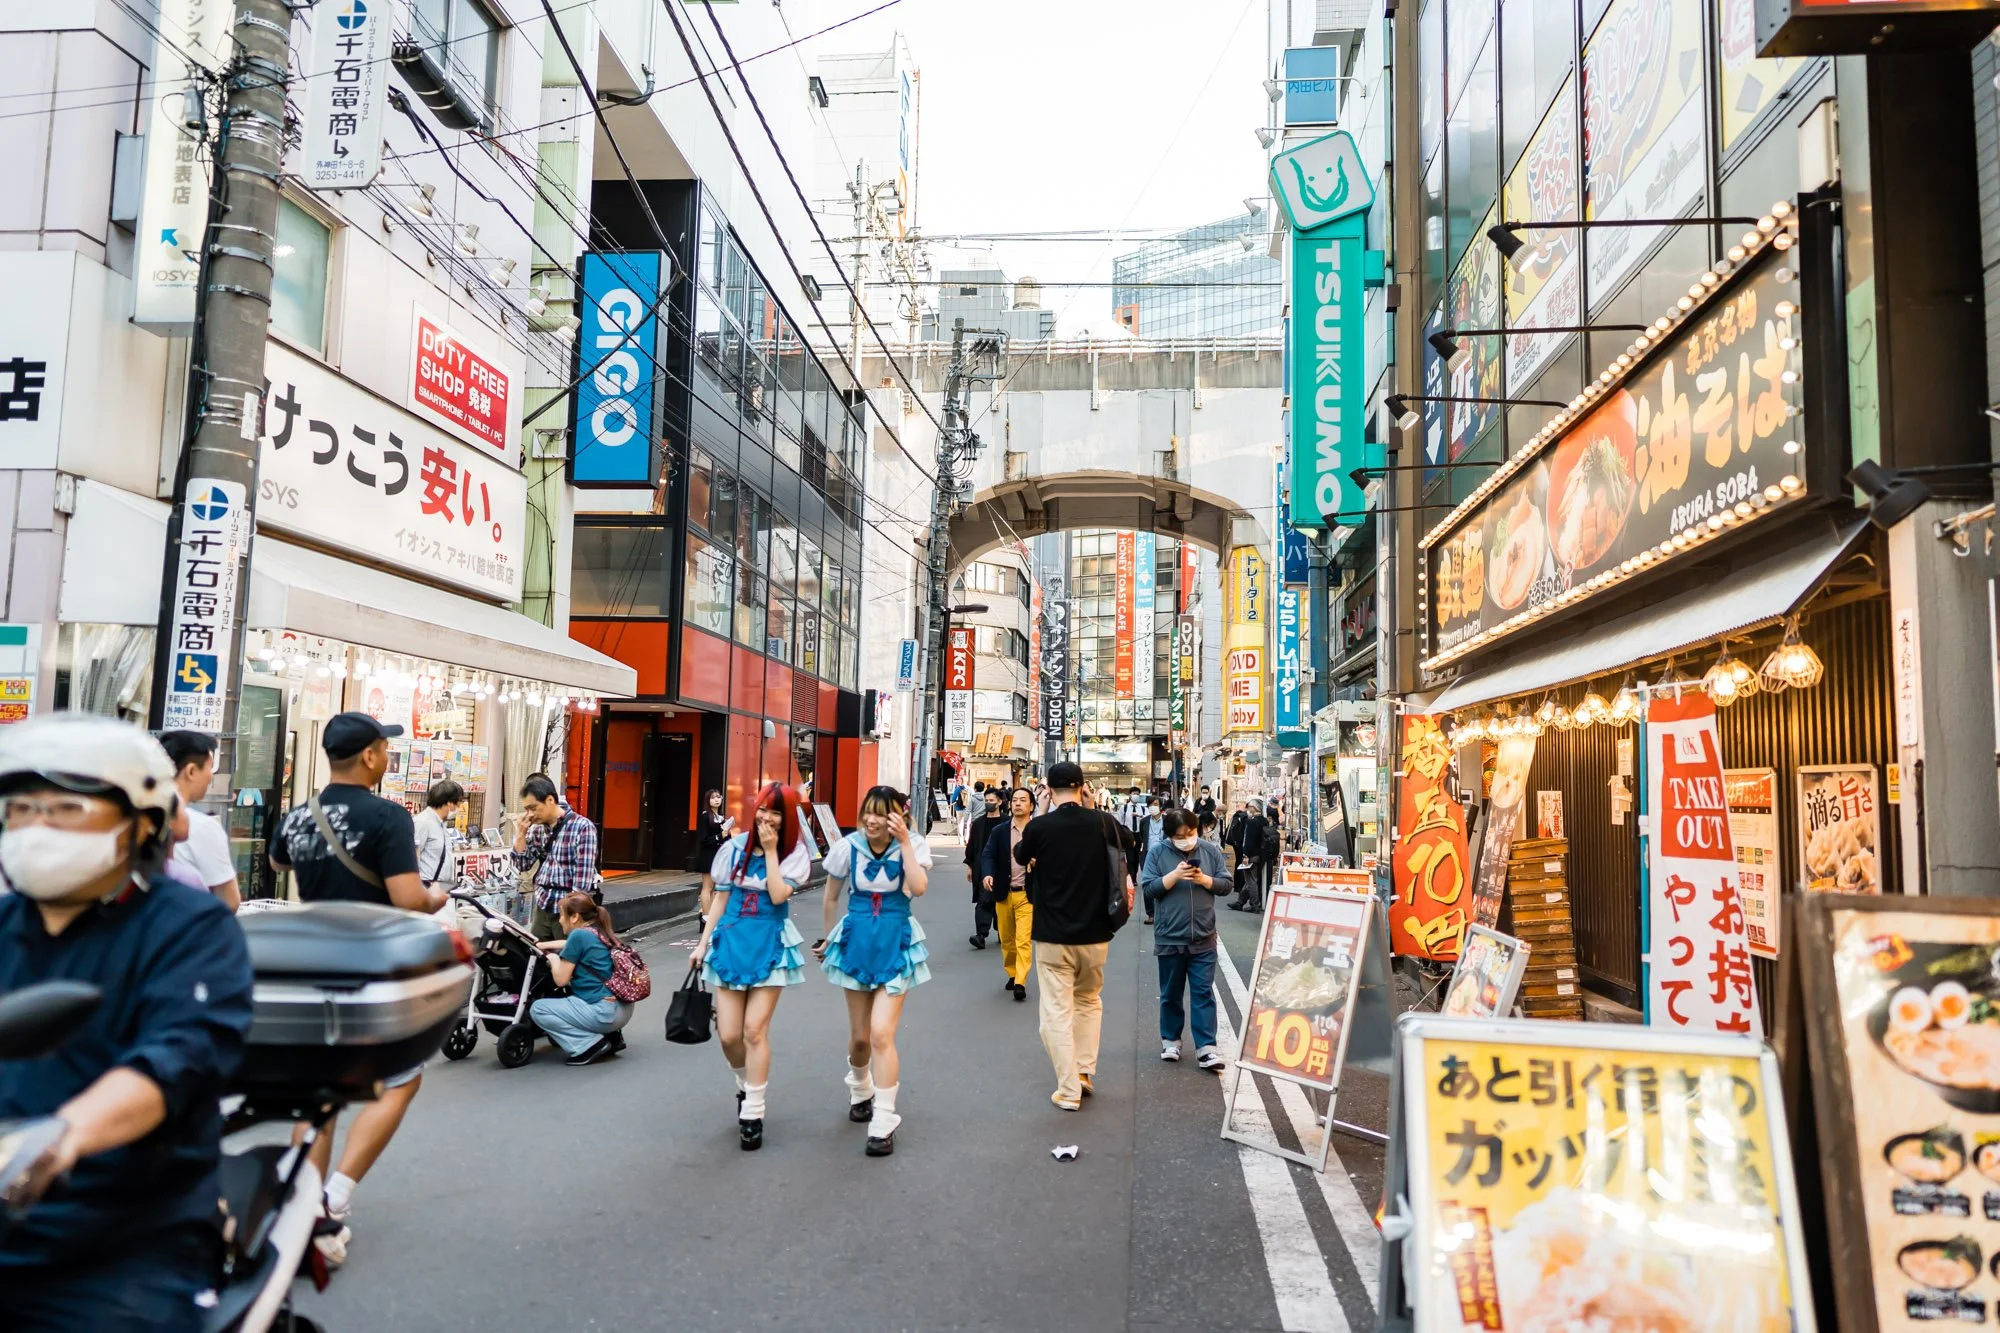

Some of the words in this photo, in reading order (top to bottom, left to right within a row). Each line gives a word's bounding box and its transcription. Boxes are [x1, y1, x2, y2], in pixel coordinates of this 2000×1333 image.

[329, 33, 364, 136] 千石電商
[1288, 79, 1336, 95] 内田ビル
[315, 170, 365, 181] 3253-4411
[421, 326, 467, 373] DUTY
[470, 359, 506, 401] FREE
[1315, 240, 1343, 516] TSUKUMO
[420, 355, 465, 398] SHOP
[468, 386, 492, 418] 免税
[418, 385, 464, 421] SMARTPHONE
[467, 414, 491, 435] TABLET
[493, 430, 503, 443] PC
[1635, 319, 1793, 516] 油そば
[1669, 489, 1714, 535] ABURA
[1716, 464, 1759, 509] SOBA
[1118, 537, 1127, 573] HONEY
[178, 530, 223, 651] 千石電商
[1118, 575, 1127, 605] TOAST
[1118, 607, 1127, 631] CAFE
[1181, 621, 1192, 656] DVD
[953, 649, 967, 687] KFC
[164, 717, 221, 729] 3253-4411
[1682, 736, 1699, 757] OK
[1669, 776, 1725, 811] TAKE
[1806, 776, 1874, 833] 滴る旨さ
[1676, 814, 1726, 851] OUT
[1256, 1010, 1311, 1068] 10
[1306, 1050, 1329, 1076] 円
